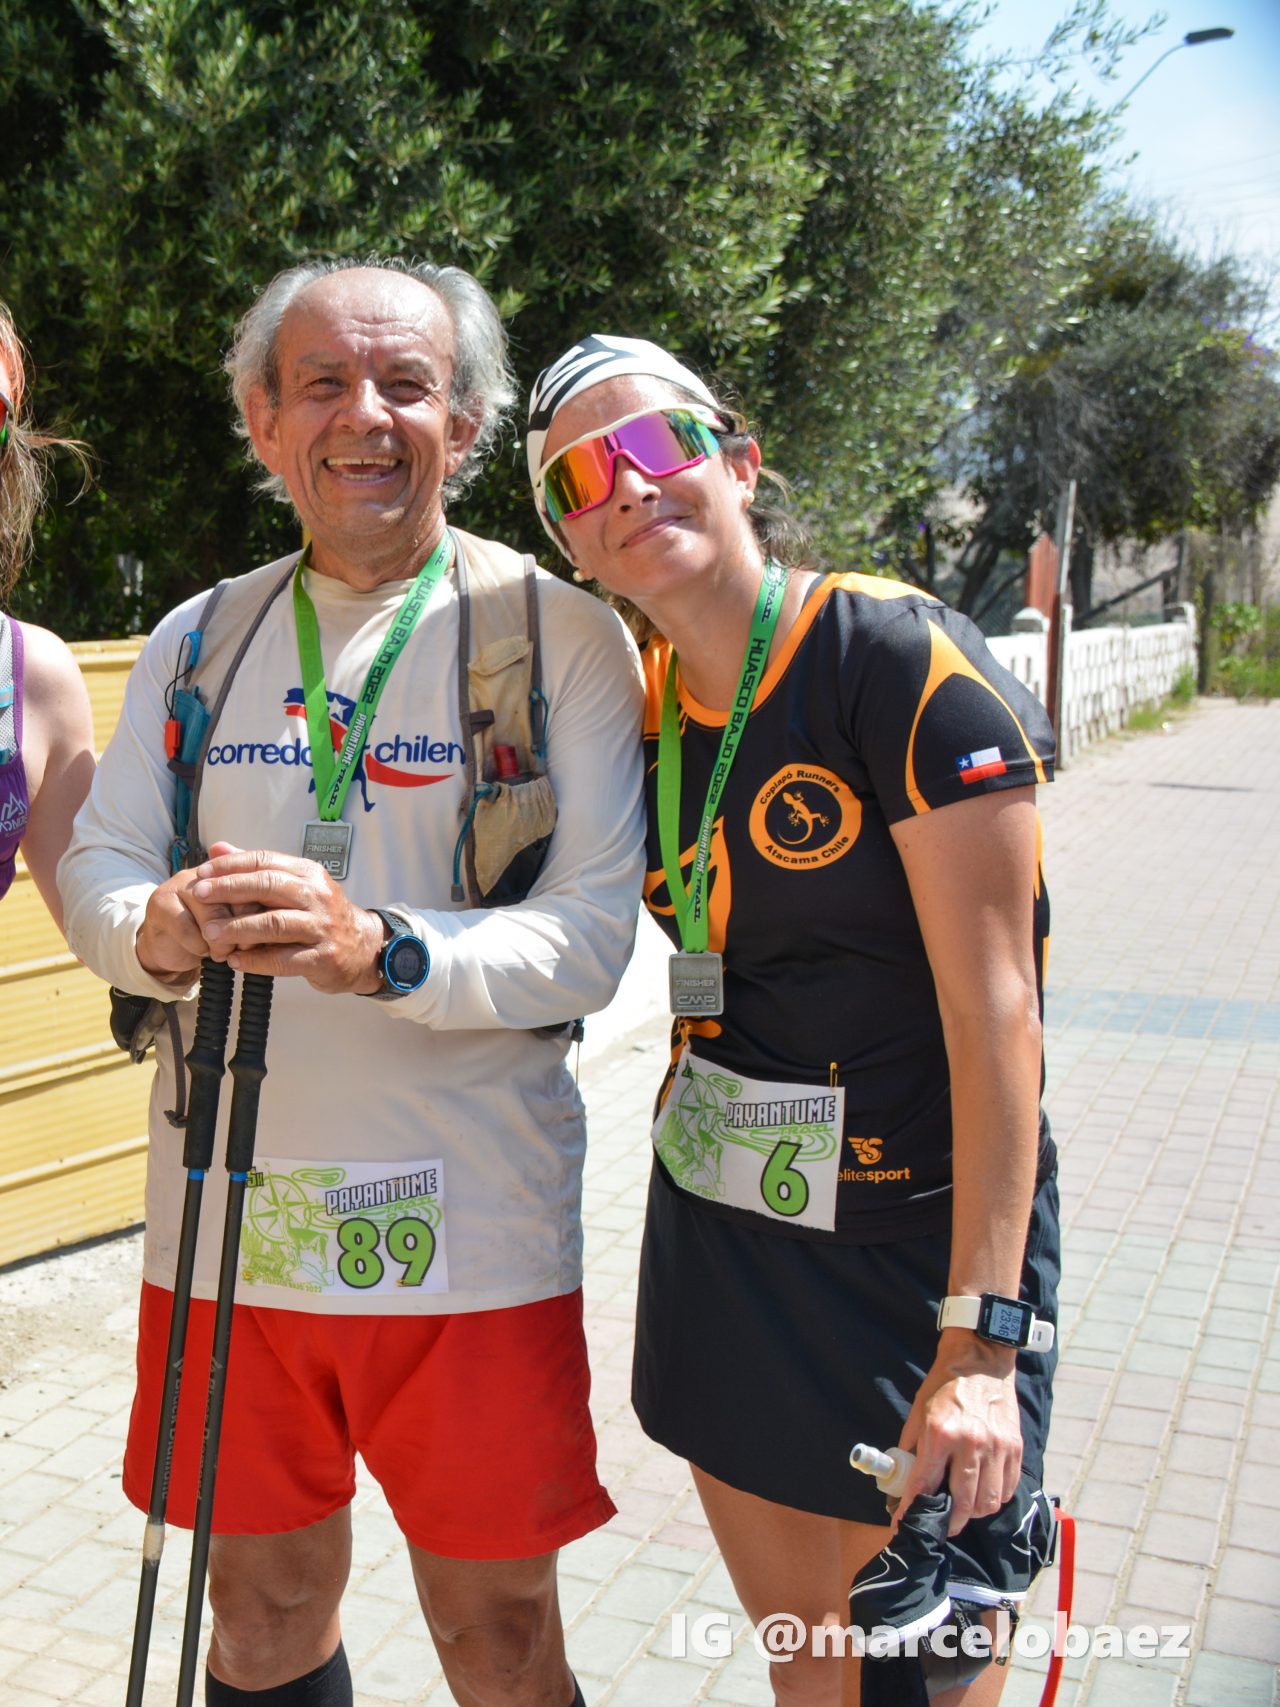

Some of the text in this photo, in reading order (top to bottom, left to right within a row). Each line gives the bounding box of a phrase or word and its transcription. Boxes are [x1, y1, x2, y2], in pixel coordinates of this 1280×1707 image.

[362, 576, 435, 704] HUASCO BAJO 2022
[709, 638, 766, 805] HUASCO BAJO 2022
[208, 738, 320, 766] corredo
[342, 713, 366, 766] PAYANTUME
[797, 770, 840, 793] Runners
[307, 844, 343, 854] FINISHER
[765, 836, 849, 864] Atacama Chile
[676, 979, 716, 988] FINISHER
[677, 995, 716, 1008] CMP
[724, 1096, 836, 1128] PAYANTUME
[325, 1168, 437, 1217] PAYANTUME
[760, 1140, 810, 1217] 6
[337, 1216, 436, 1290] 89
